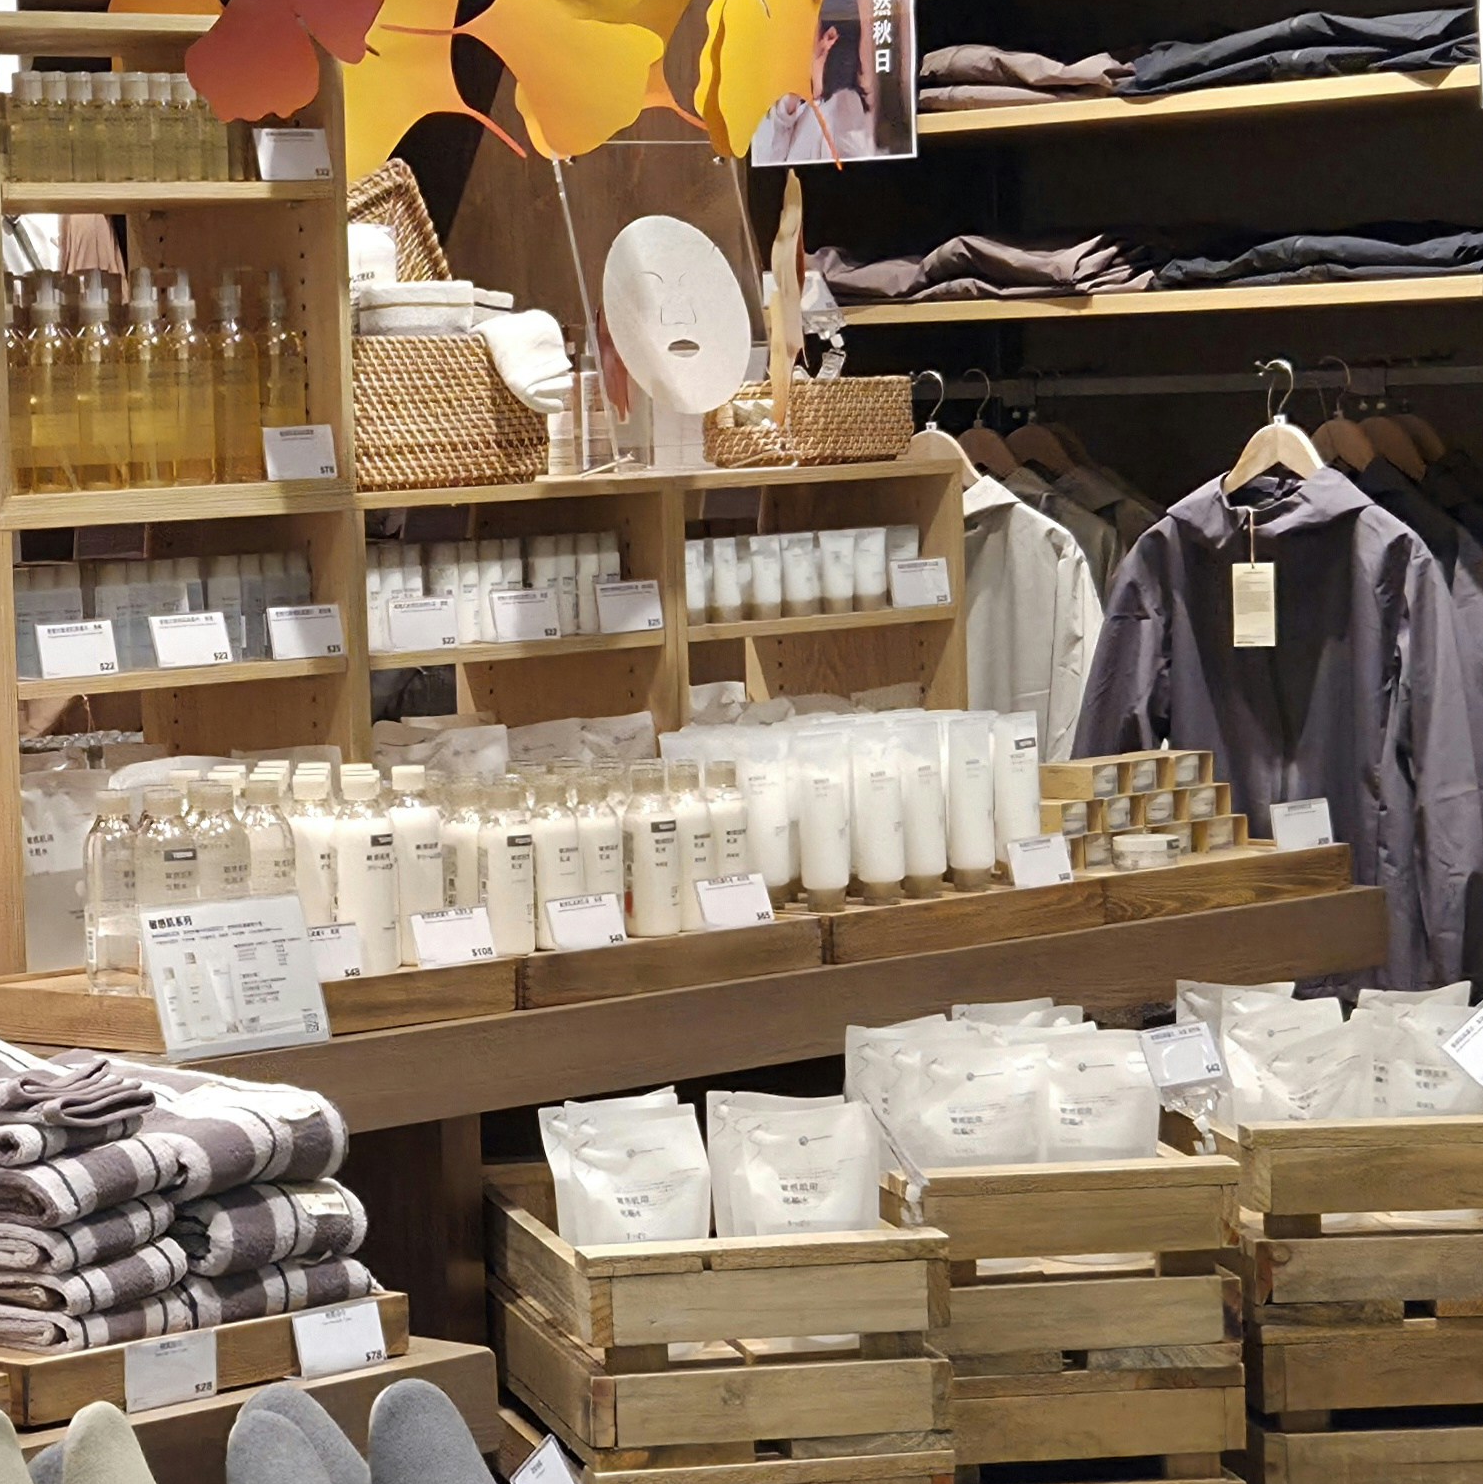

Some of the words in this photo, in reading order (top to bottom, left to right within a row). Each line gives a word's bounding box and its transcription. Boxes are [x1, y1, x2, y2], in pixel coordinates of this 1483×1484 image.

[442, 637, 455, 645] $22
[100, 662, 114, 671] $22
[472, 947, 493, 957] $108
[365, 1350, 383, 1362] $78
[195, 1381, 212, 1393] $28
